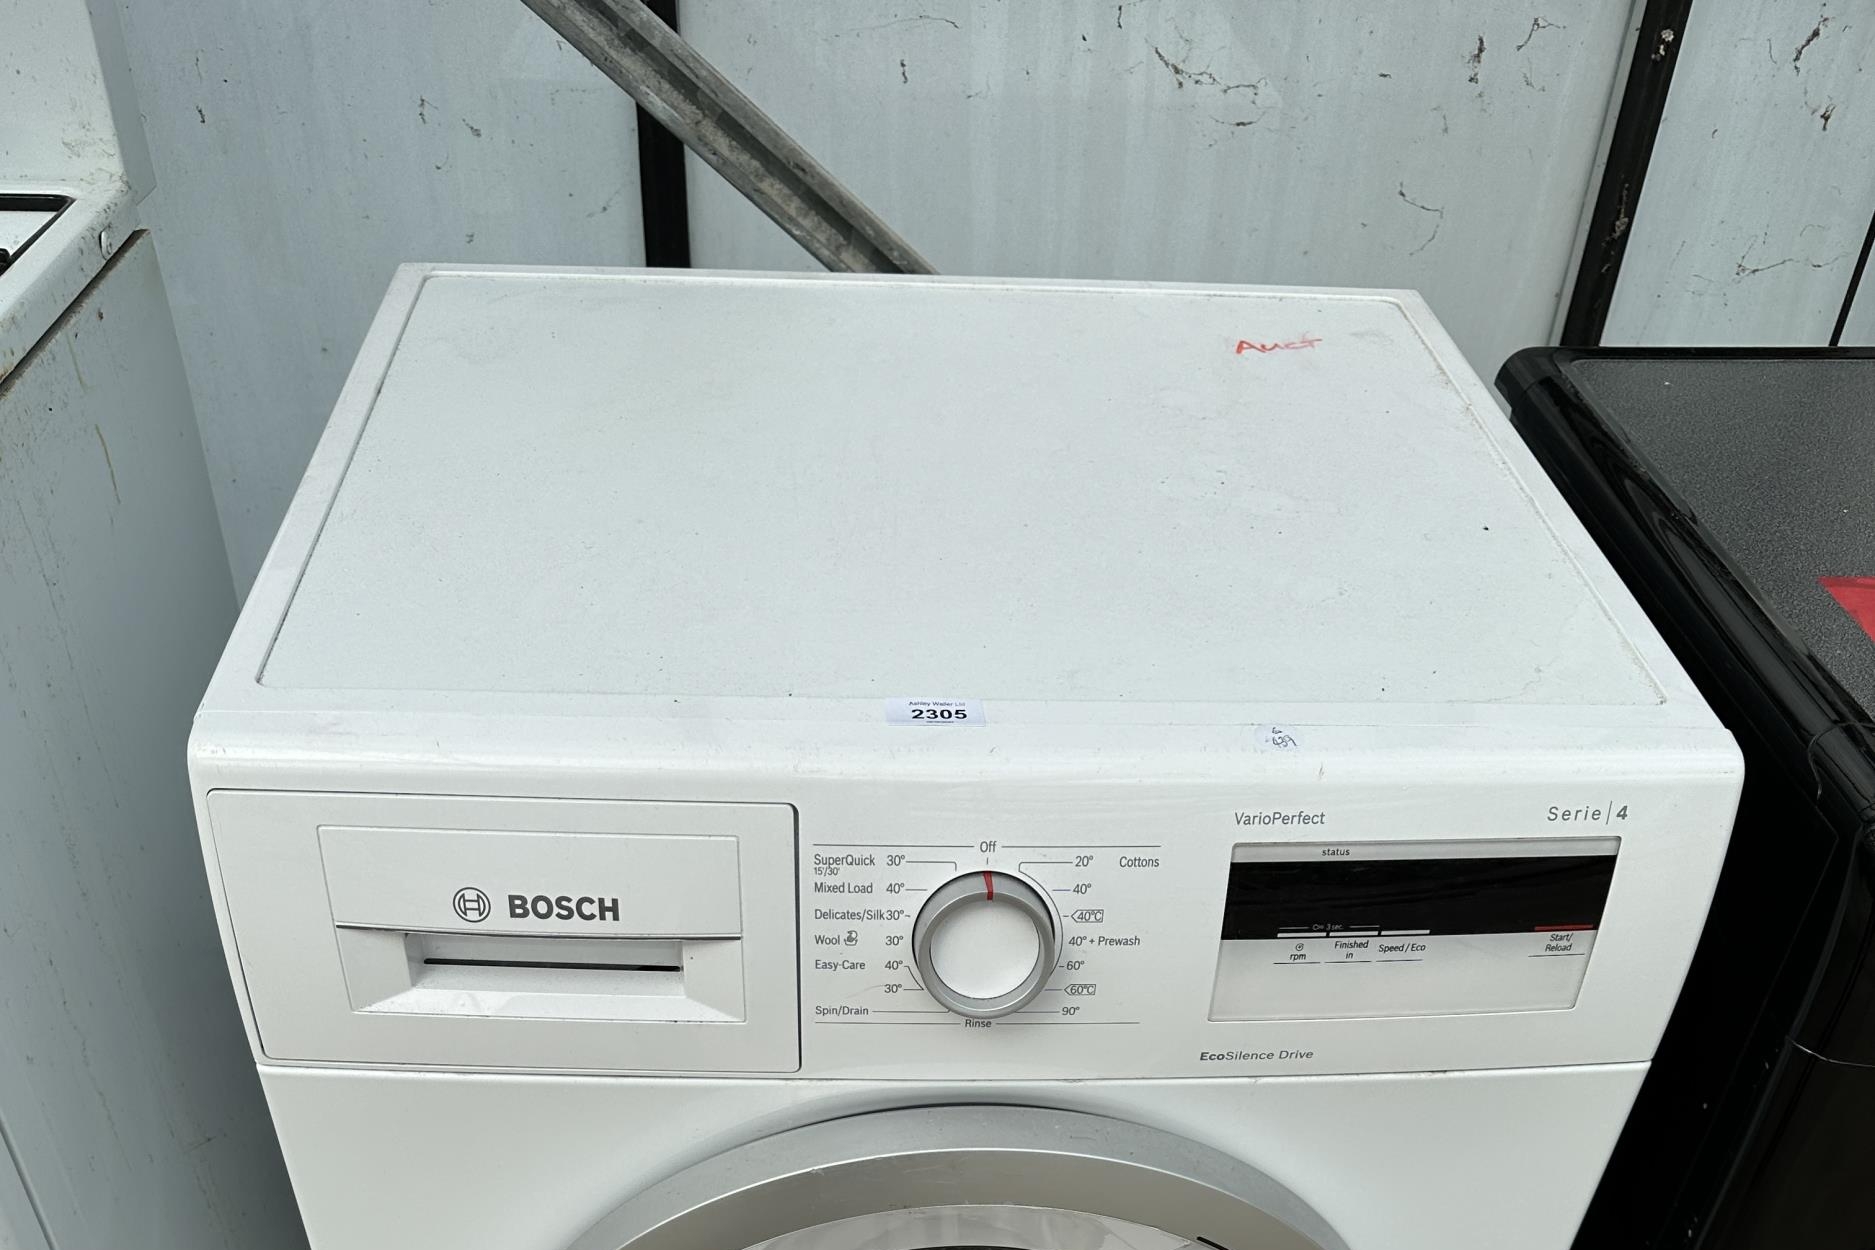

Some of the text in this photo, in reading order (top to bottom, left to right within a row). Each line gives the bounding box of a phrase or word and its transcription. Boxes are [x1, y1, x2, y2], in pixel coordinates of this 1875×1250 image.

[911, 709, 967, 719] 2305
[1234, 811, 1325, 827] VarioPerfect
[1547, 805, 1602, 822] Serie
[1616, 805, 1629, 821] 4
[980, 840, 997, 853] Off
[1321, 847, 1351, 857] status
[814, 853, 906, 869] SuperQuick 30°
[1075, 855, 1160, 868] 20° Cottons
[814, 882, 905, 895] Mixed Load 40°
[1072, 883, 1092, 895] 40°
[508, 894, 620, 922] BOSCH
[814, 934, 904, 946] Wool 30°
[1068, 935, 1087, 947] 40°
[1098, 935, 1141, 947] Prewash
[1549, 932, 1574, 942] Start/
[1334, 940, 1369, 949] Finished
[1379, 943, 1404, 953] Speed
[1411, 943, 1426, 952] Eco
[1545, 943, 1573, 952] Reload
[1289, 953, 1307, 961] rpm
[1345, 951, 1354, 959] in
[814, 959, 903, 972] Easy-Care 40°
[1066, 960, 1085, 971] 60°
[884, 983, 902, 995] 30°
[815, 1005, 869, 1017] Spin/Drain
[1061, 1006, 1080, 1017] 90°
[965, 1018, 992, 1028] Rinse
[1199, 1048, 1314, 1061] EcoSilence Drive
